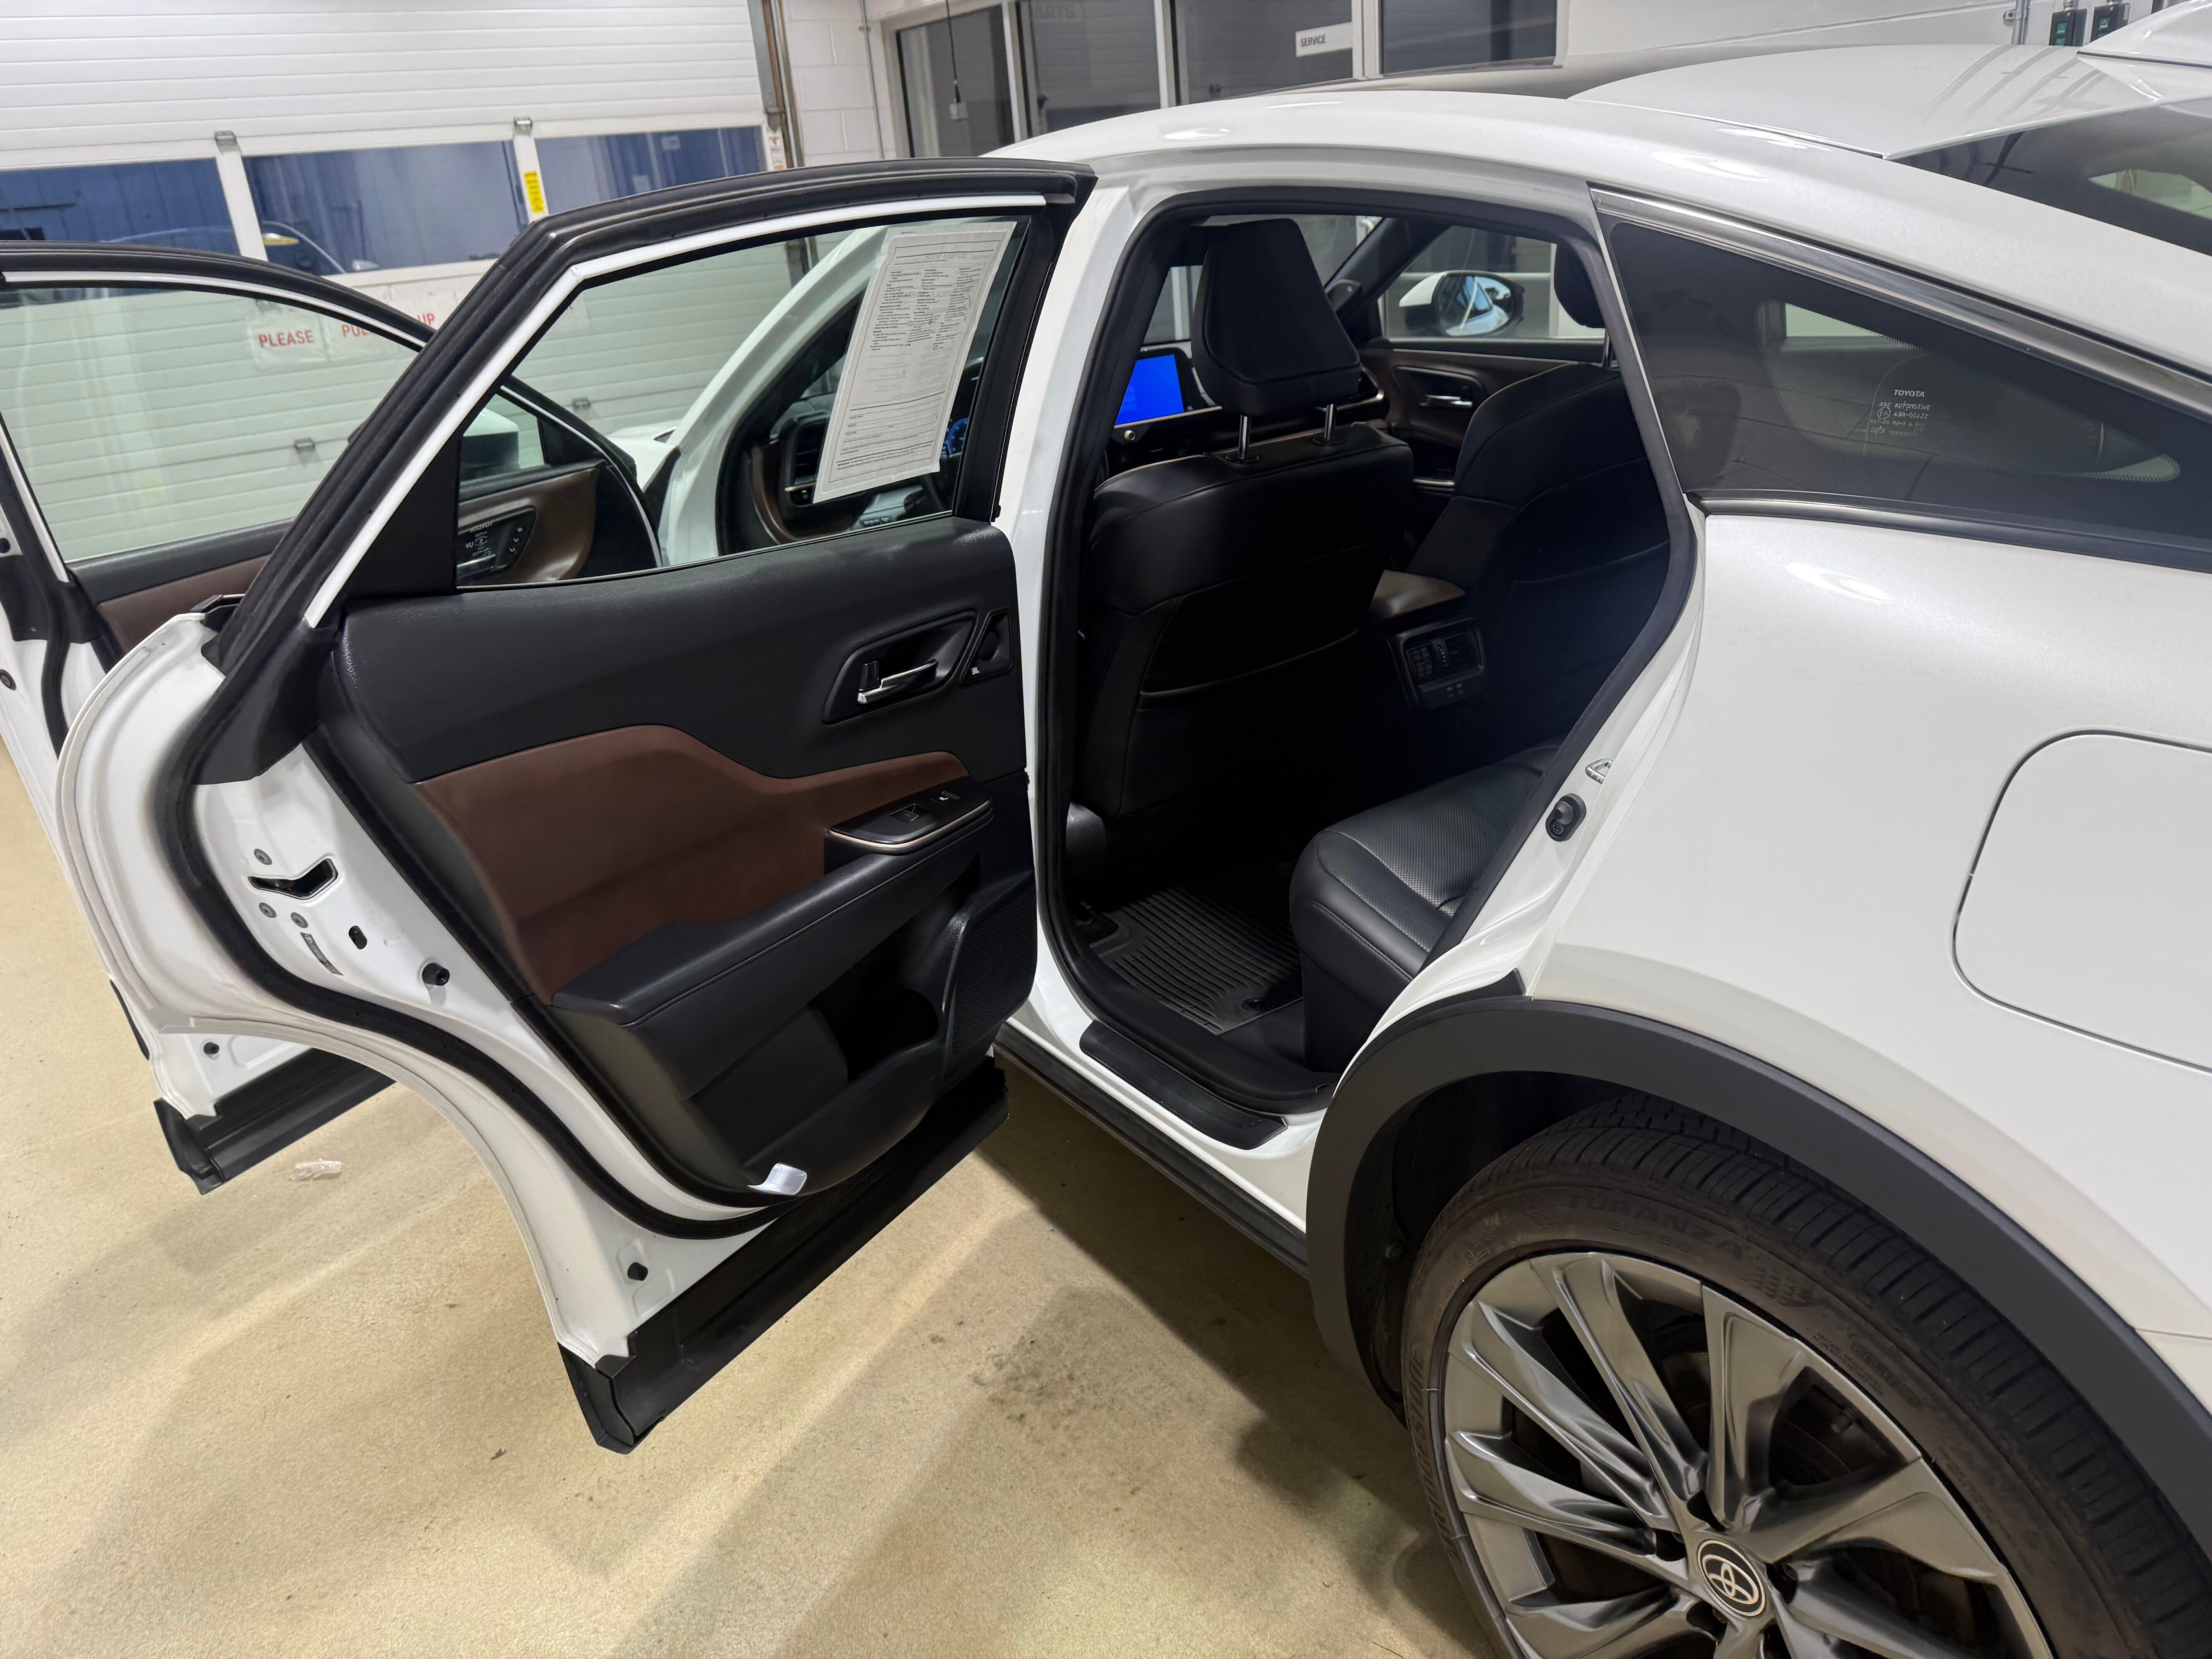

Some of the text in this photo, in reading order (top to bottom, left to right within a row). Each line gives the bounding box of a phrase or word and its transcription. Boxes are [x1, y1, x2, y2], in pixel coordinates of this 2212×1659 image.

[1301, 34, 1326, 46] SERVICE
[258, 313, 435, 347] PLEASE PUL UP
[1566, 1192, 1745, 1261] TURANZA
